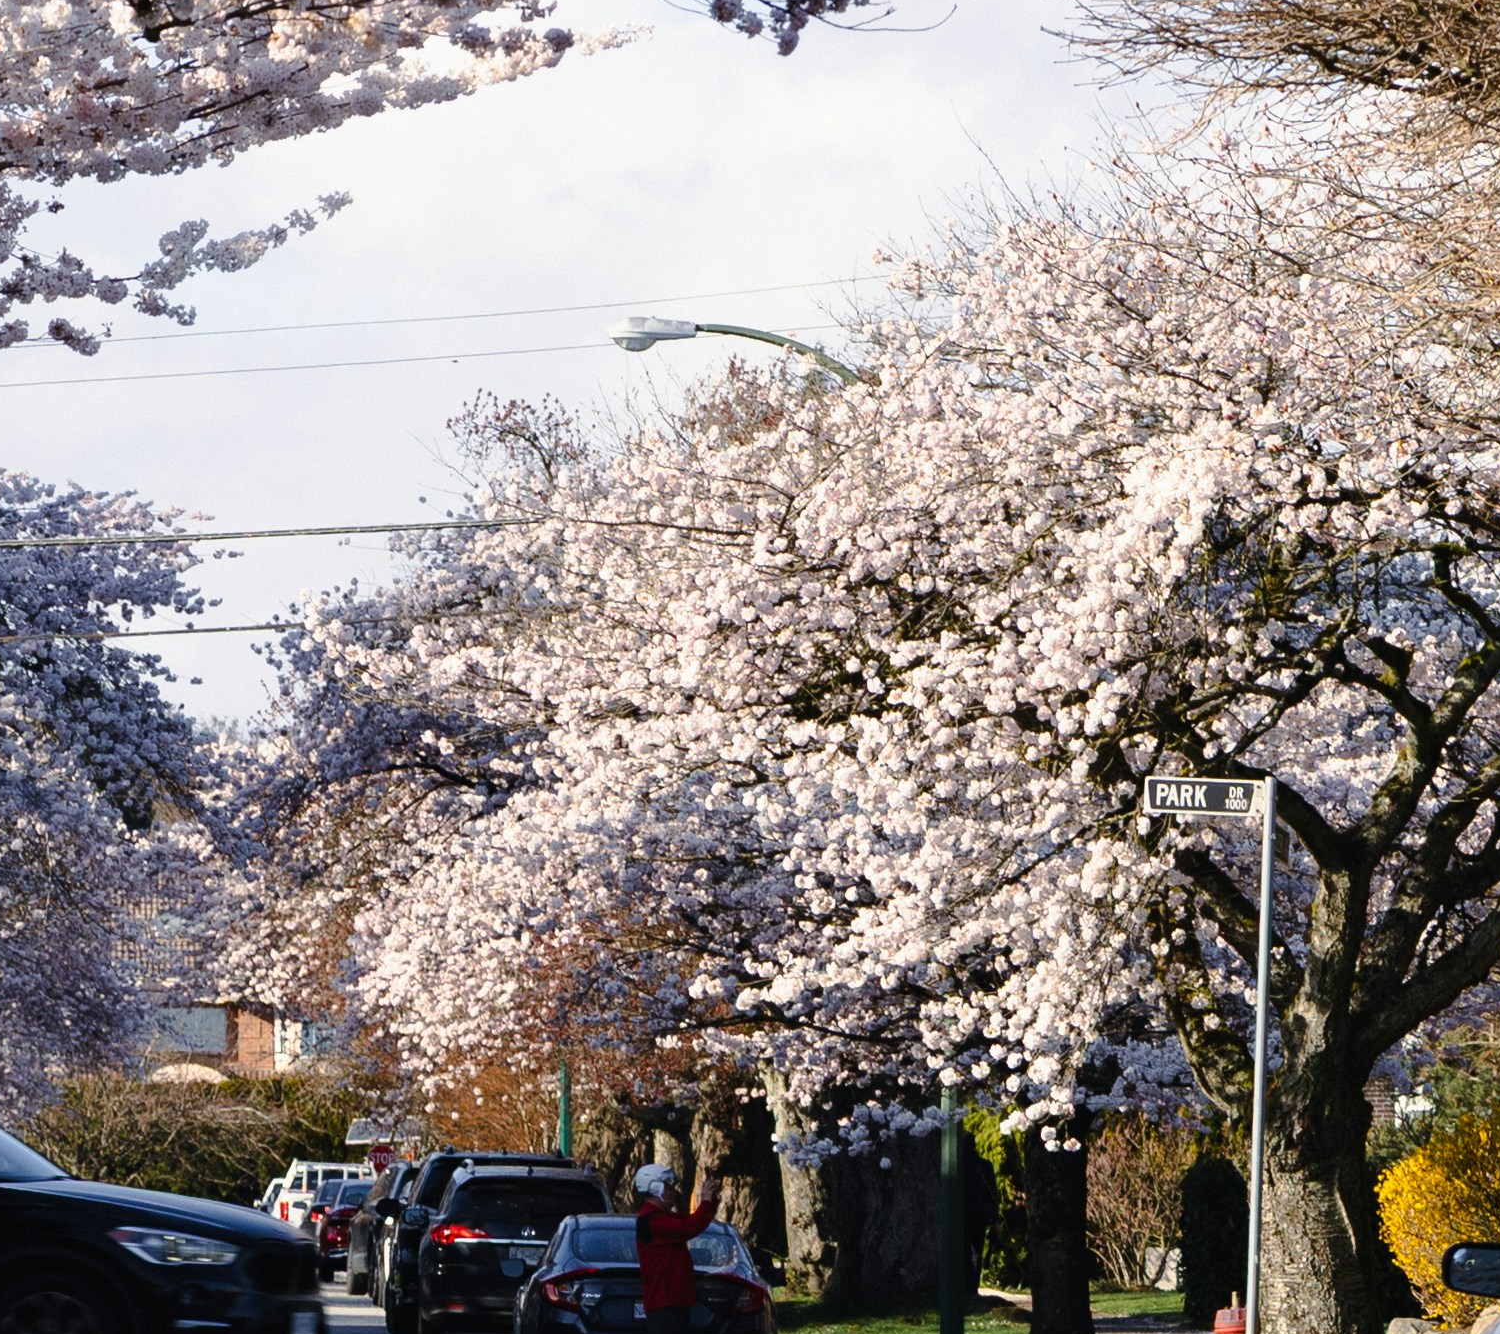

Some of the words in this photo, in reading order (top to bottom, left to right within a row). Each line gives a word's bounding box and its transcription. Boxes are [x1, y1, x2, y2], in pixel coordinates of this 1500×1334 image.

[1155, 783, 1208, 808] PARK
[1228, 786, 1244, 799] DR
[1225, 798, 1248, 810] 1000
[369, 1152, 395, 1165] STOP
